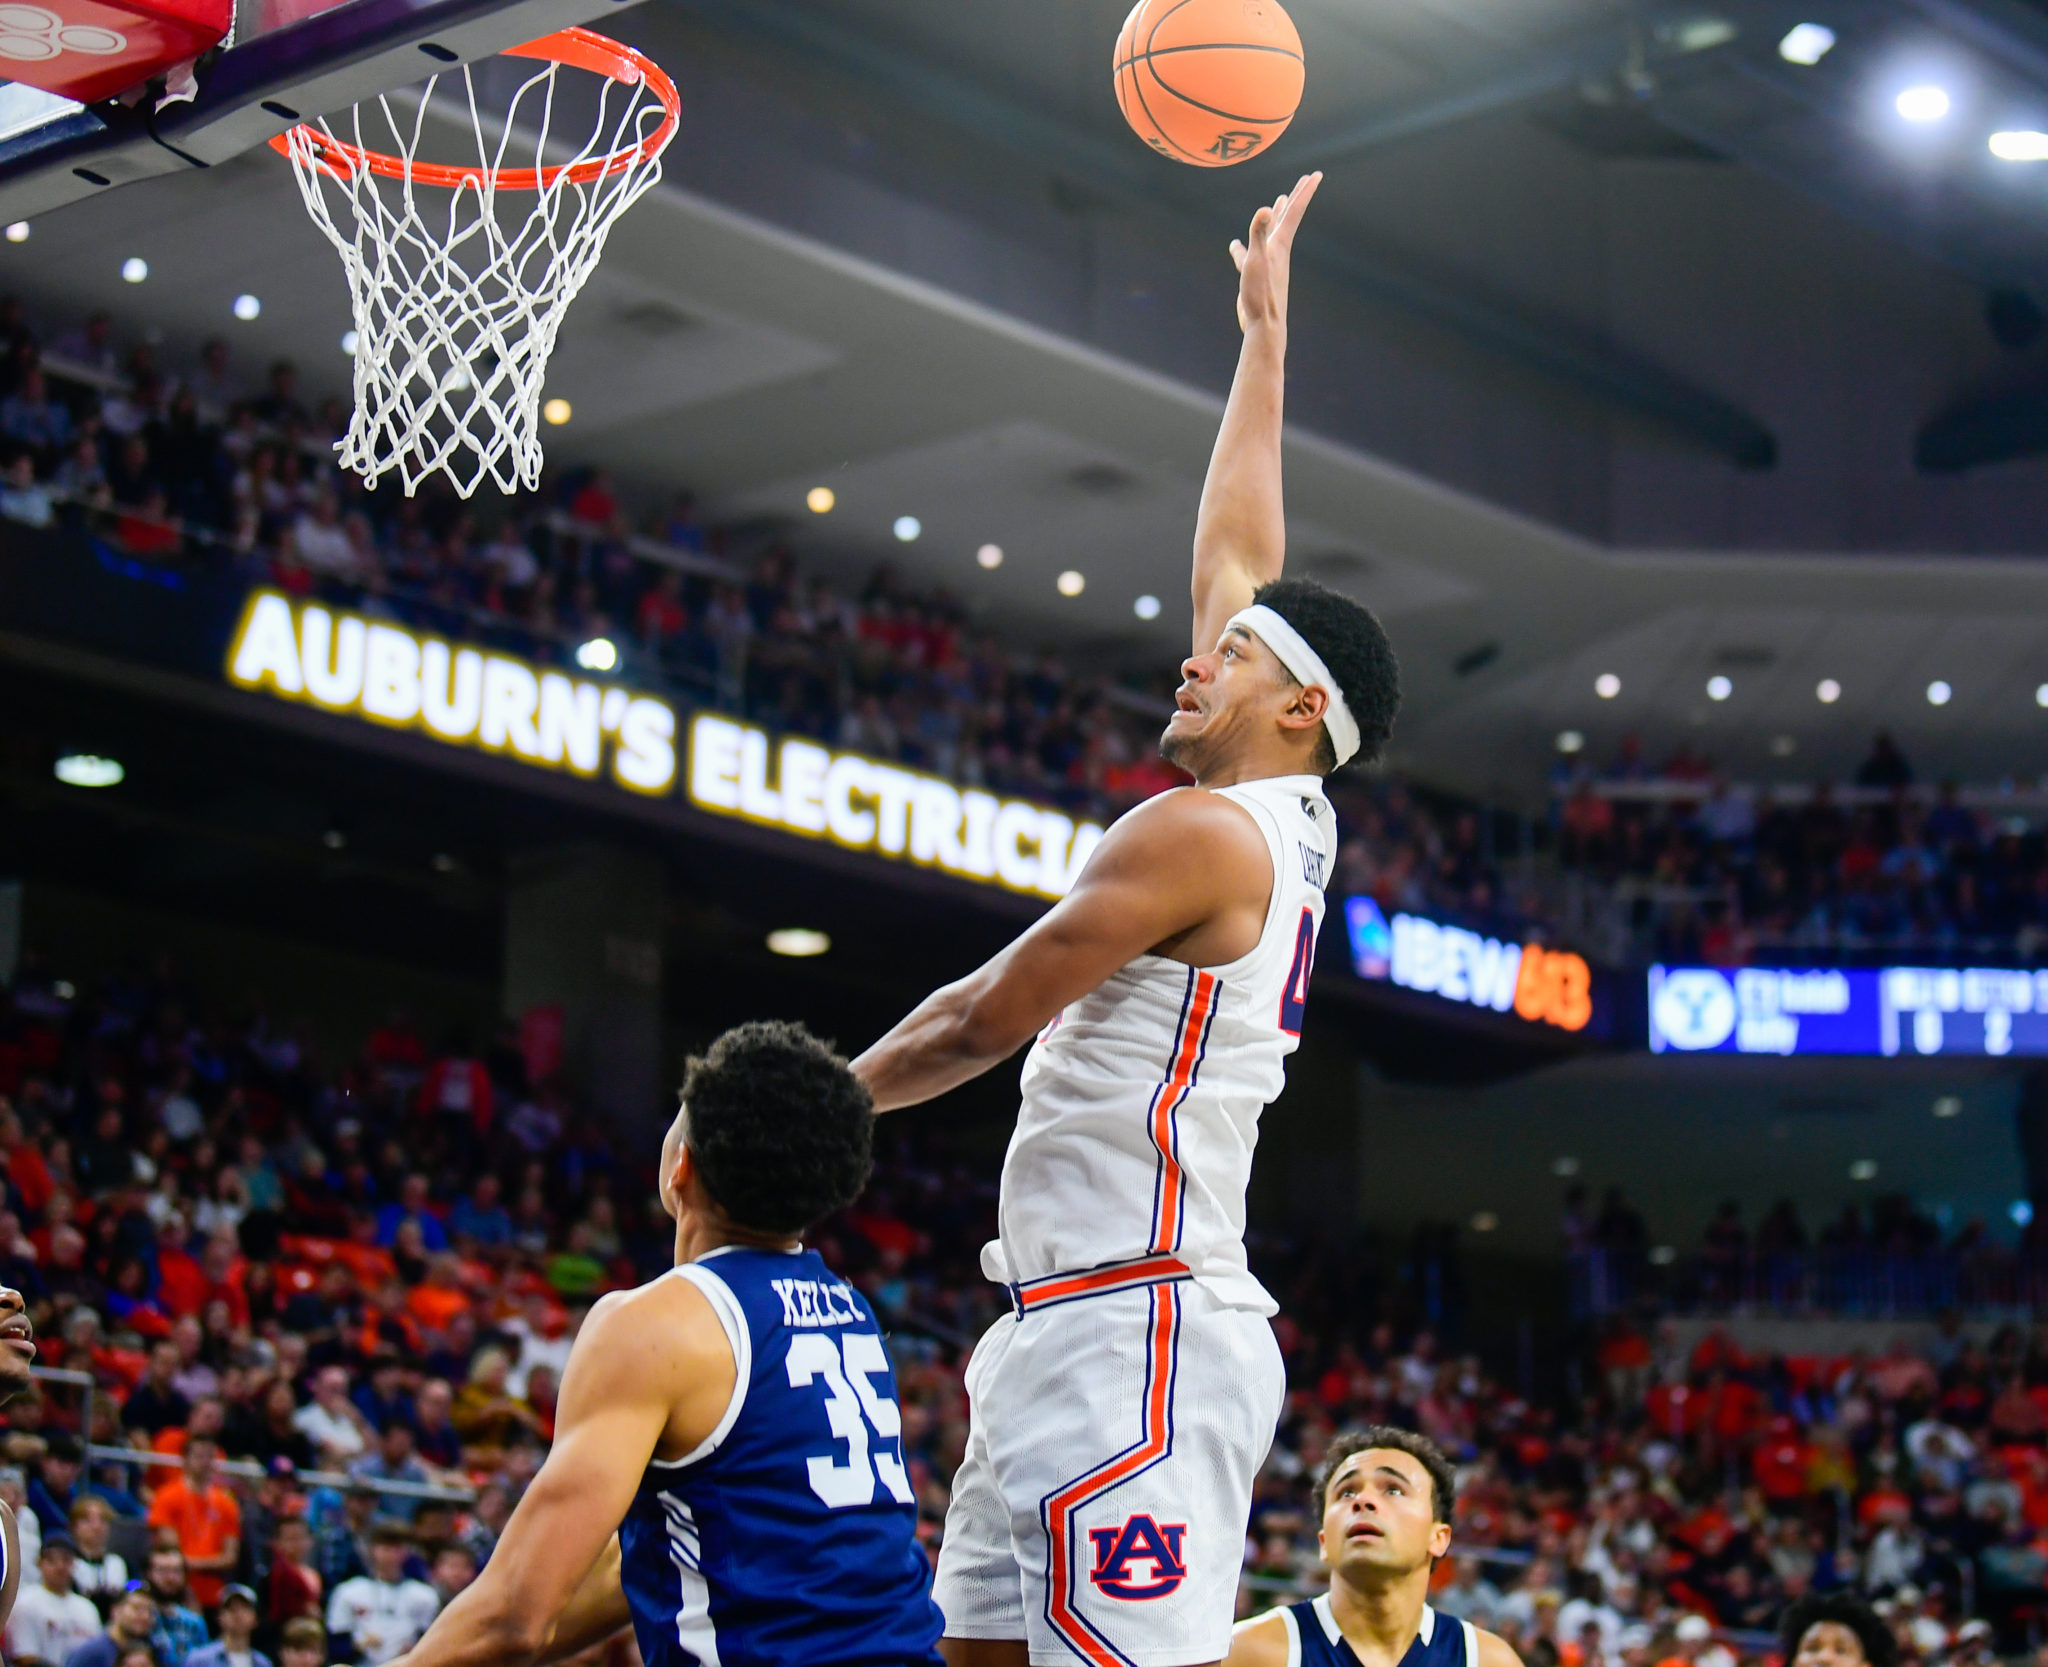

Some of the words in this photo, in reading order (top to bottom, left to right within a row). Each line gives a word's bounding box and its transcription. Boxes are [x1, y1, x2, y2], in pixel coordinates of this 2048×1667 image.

[228, 588, 676, 793] AUBURN'S
[770, 1278, 866, 1327] KELLY
[785, 1333, 915, 1509] 35
